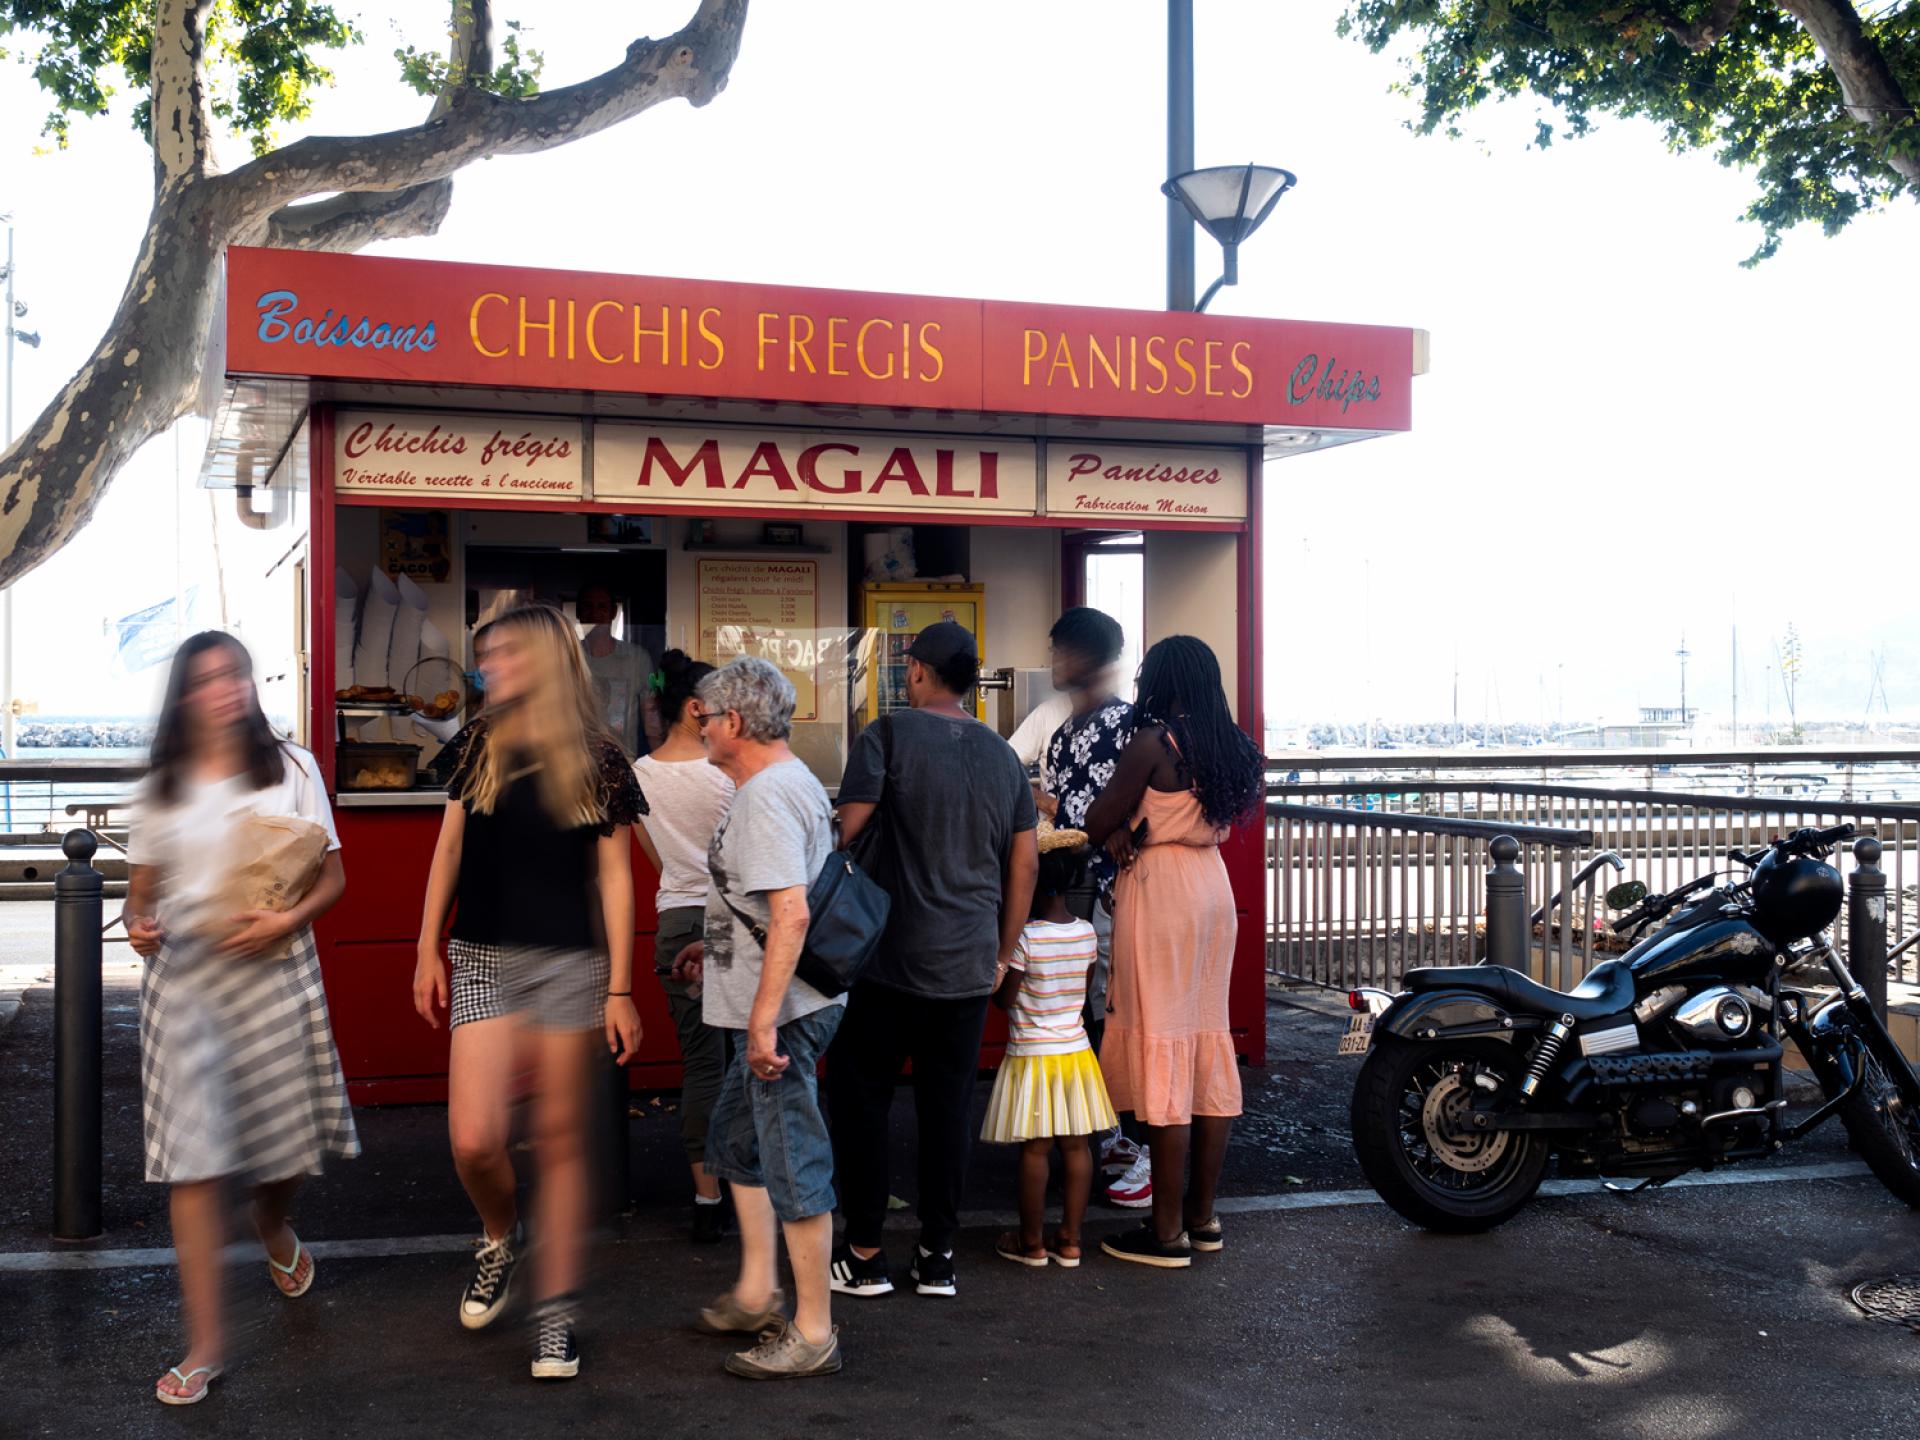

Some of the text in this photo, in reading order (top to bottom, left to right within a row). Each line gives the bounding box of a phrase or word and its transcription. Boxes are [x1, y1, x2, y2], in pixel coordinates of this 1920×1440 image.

[256, 290, 437, 353] Boissons
[469, 293, 944, 382] CHICHIS FREGIS
[1022, 329, 1254, 398] PANISSES
[1286, 354, 1382, 412] Chips
[344, 421, 572, 467] Chichis frégis
[636, 437, 999, 499] MAGALI
[1068, 453, 1223, 485] Panisses
[342, 467, 417, 485] Véritable
[424, 473, 475, 487] recette
[498, 472, 575, 490] l'ancienne
[1074, 494, 1209, 514] Fabrication Maison
[767, 566, 810, 574] MAGALI
